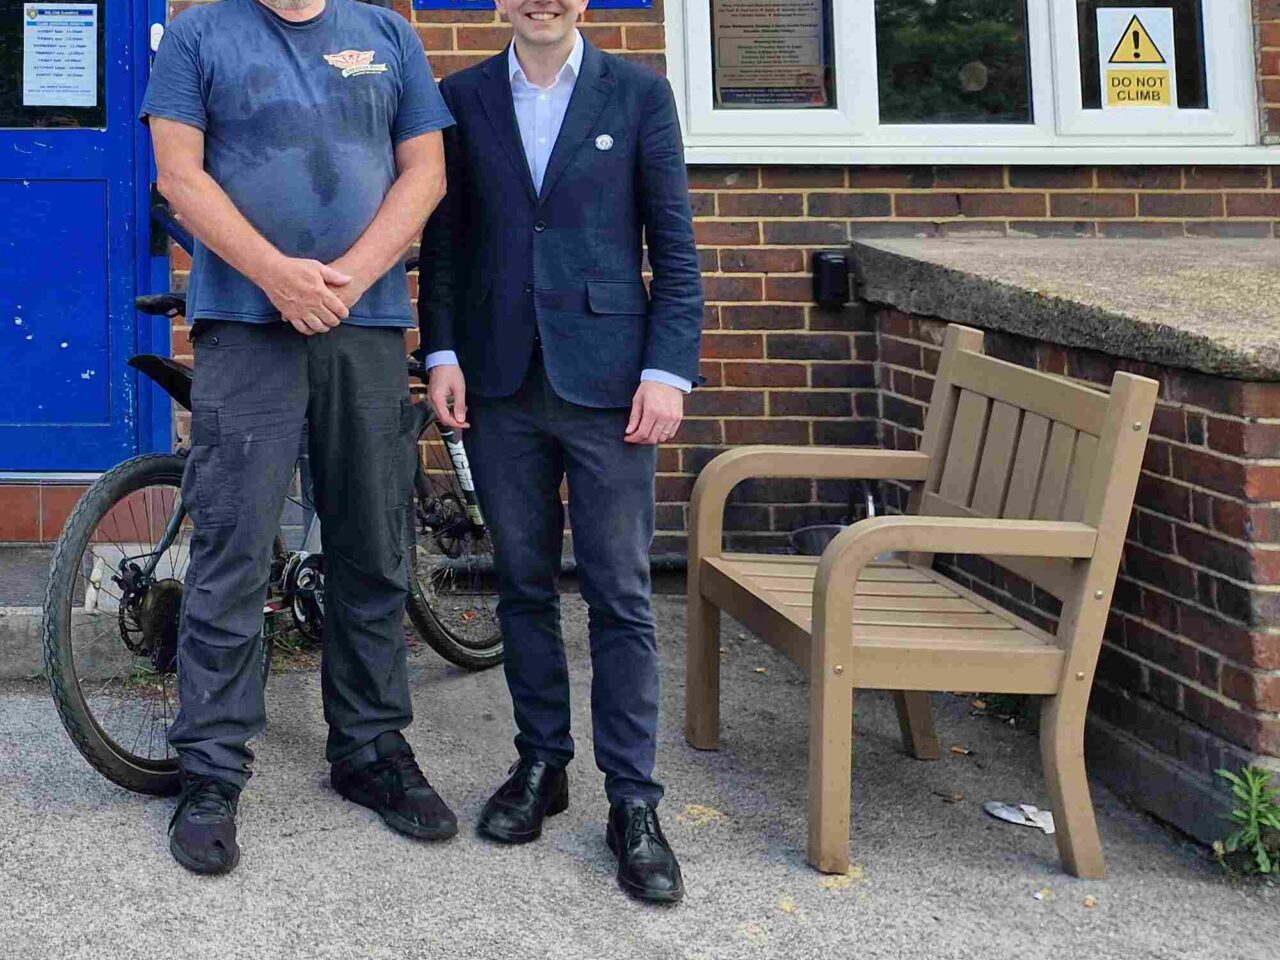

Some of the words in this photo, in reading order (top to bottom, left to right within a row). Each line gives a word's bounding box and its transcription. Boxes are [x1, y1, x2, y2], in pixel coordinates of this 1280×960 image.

[1111, 76, 1132, 88] DO
[1136, 76, 1165, 88] NOT
[1117, 90, 1161, 101] CLIMB
